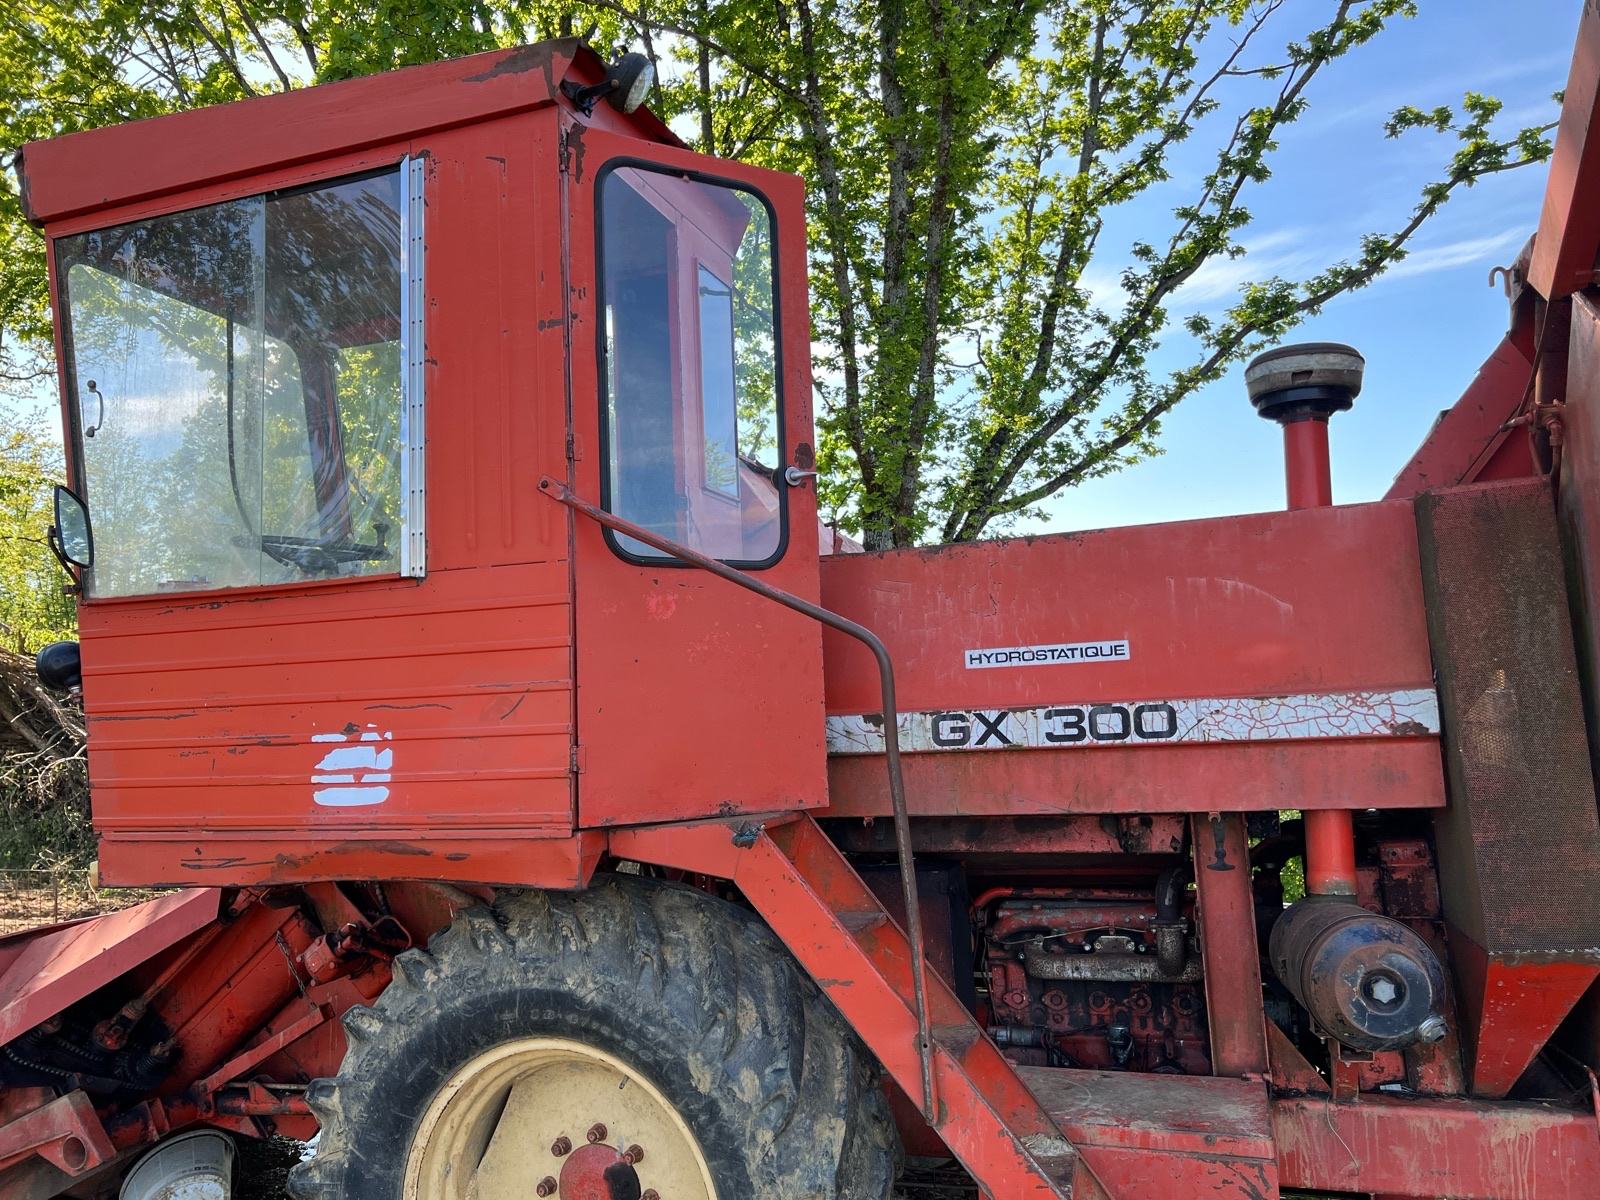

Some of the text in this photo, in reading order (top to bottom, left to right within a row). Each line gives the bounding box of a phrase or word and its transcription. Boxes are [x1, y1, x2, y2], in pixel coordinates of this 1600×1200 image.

[969, 644, 1126, 665] HYDROSTATIQUE
[931, 703, 1178, 747] GX 300
